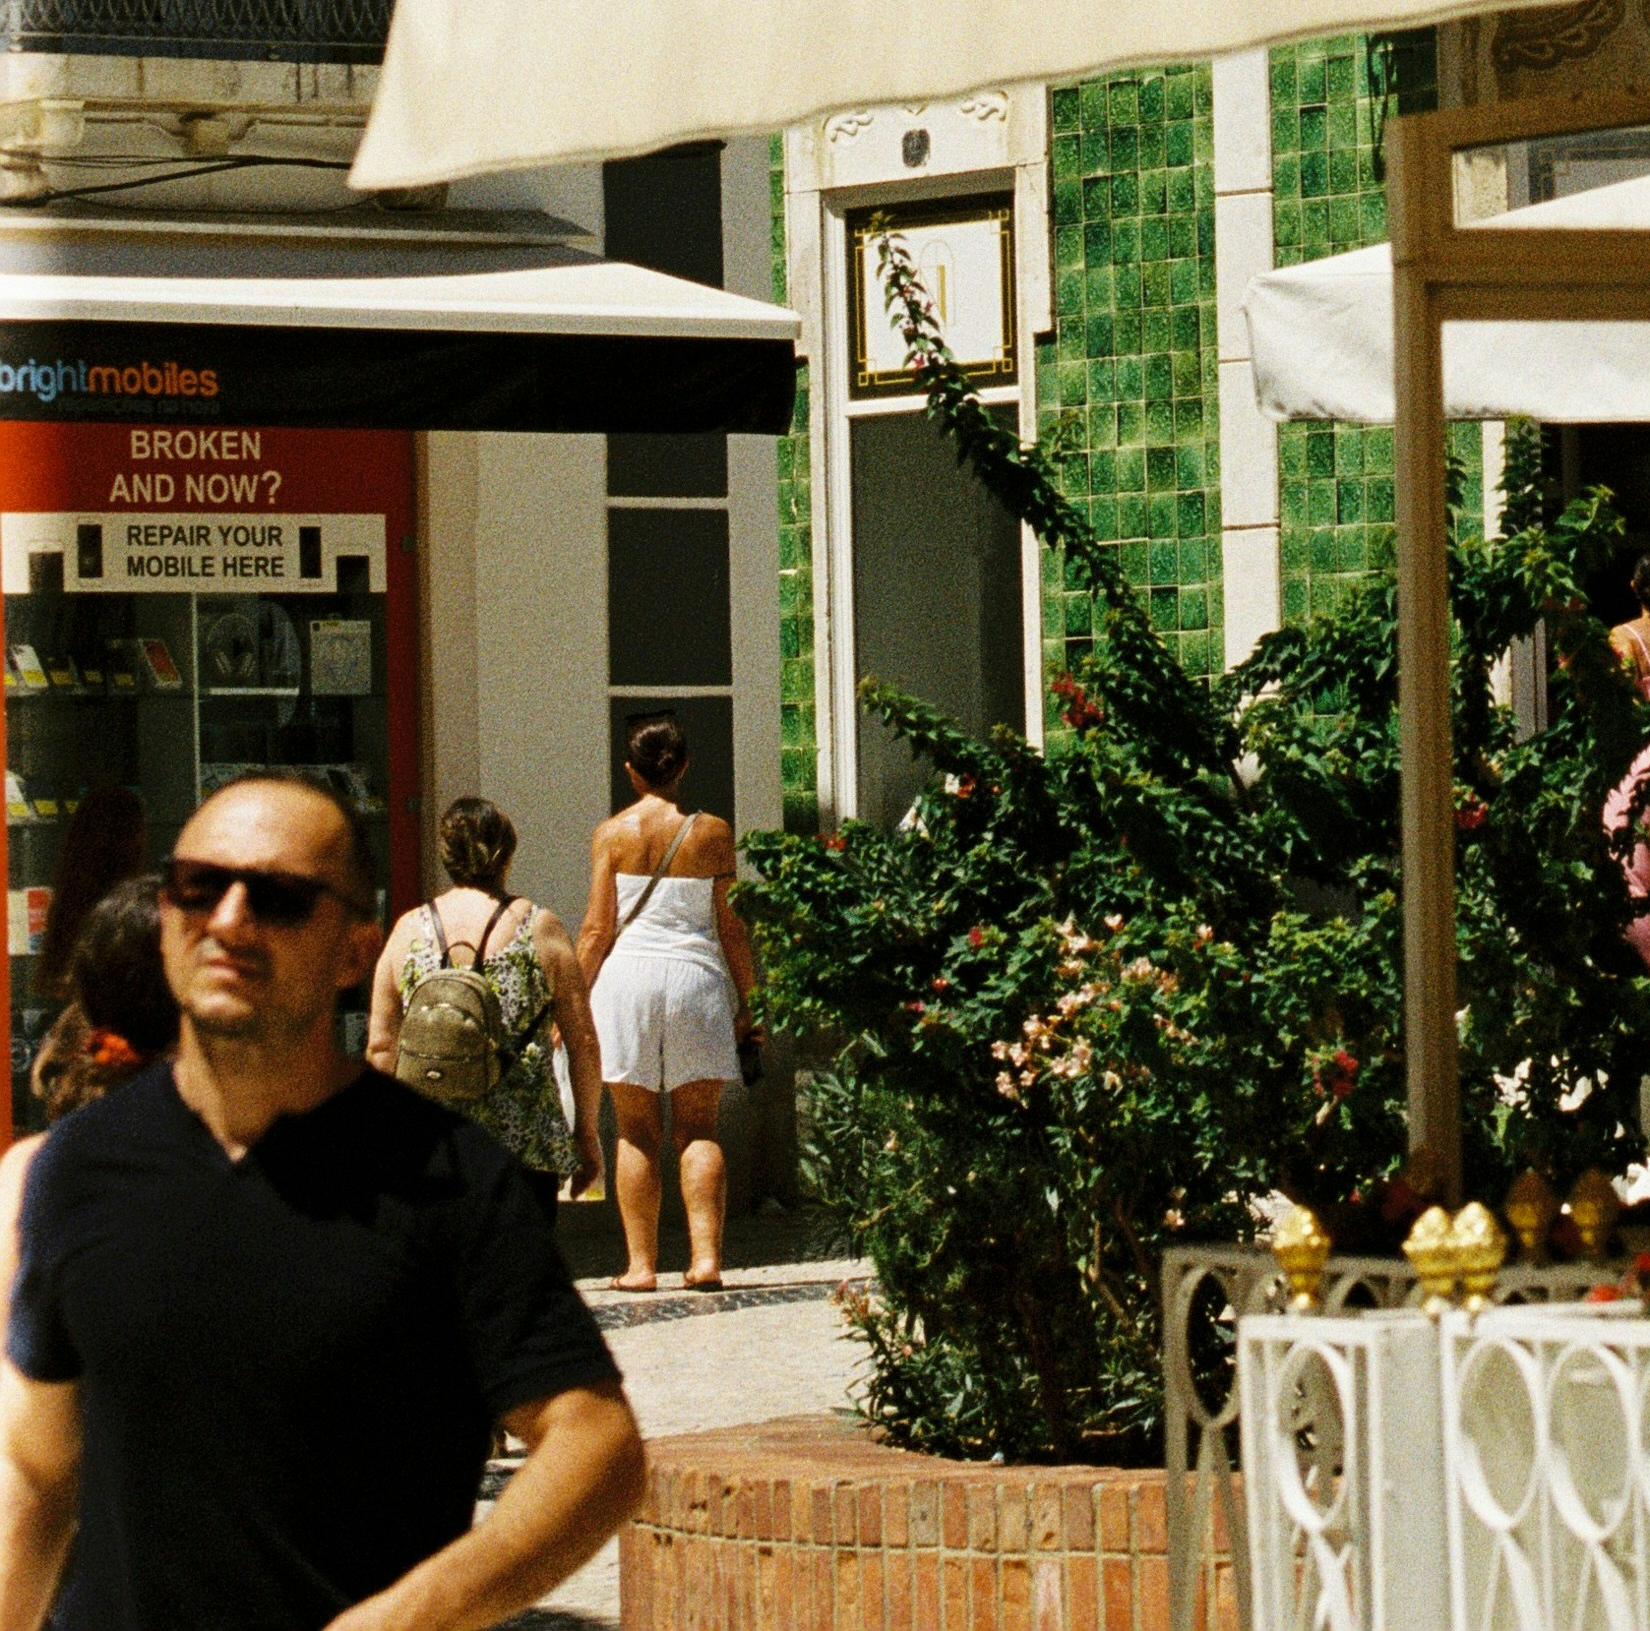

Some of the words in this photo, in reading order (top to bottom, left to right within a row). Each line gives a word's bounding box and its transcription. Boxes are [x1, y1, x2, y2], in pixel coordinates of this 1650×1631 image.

[130, 430, 261, 460] BROKEN
[109, 473, 175, 504] AND
[185, 470, 282, 505] NOW?
[127, 525, 211, 547] REPAIR
[217, 525, 283, 547] YOUR
[127, 556, 216, 577] MOBILE
[222, 556, 285, 578] HERE
